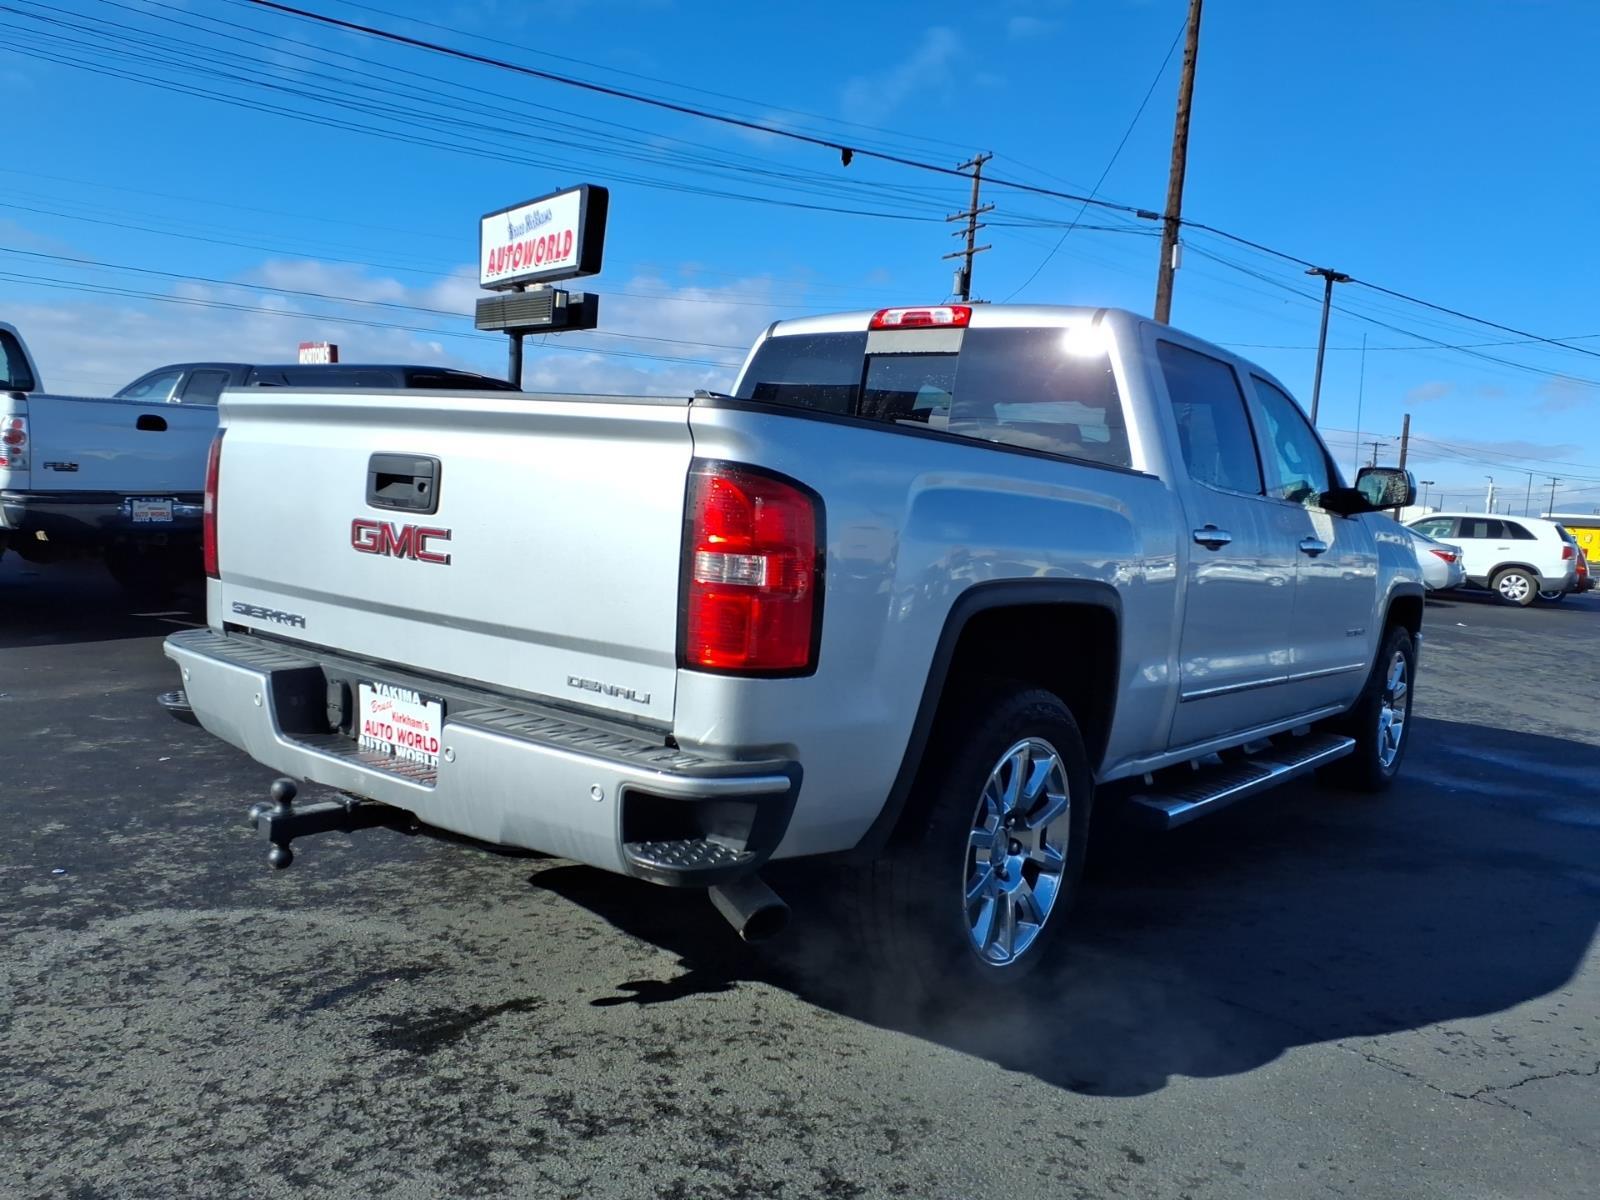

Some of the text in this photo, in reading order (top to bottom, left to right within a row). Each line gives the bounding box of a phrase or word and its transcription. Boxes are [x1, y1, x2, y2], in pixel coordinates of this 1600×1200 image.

[487, 229, 573, 275] AUTOWORLD
[351, 518, 452, 565] GMC
[231, 601, 306, 629] SIERRA
[373, 682, 420, 705] YAKIMA
[567, 675, 651, 704] DENALI
[365, 720, 438, 753] AUTO WORLD
